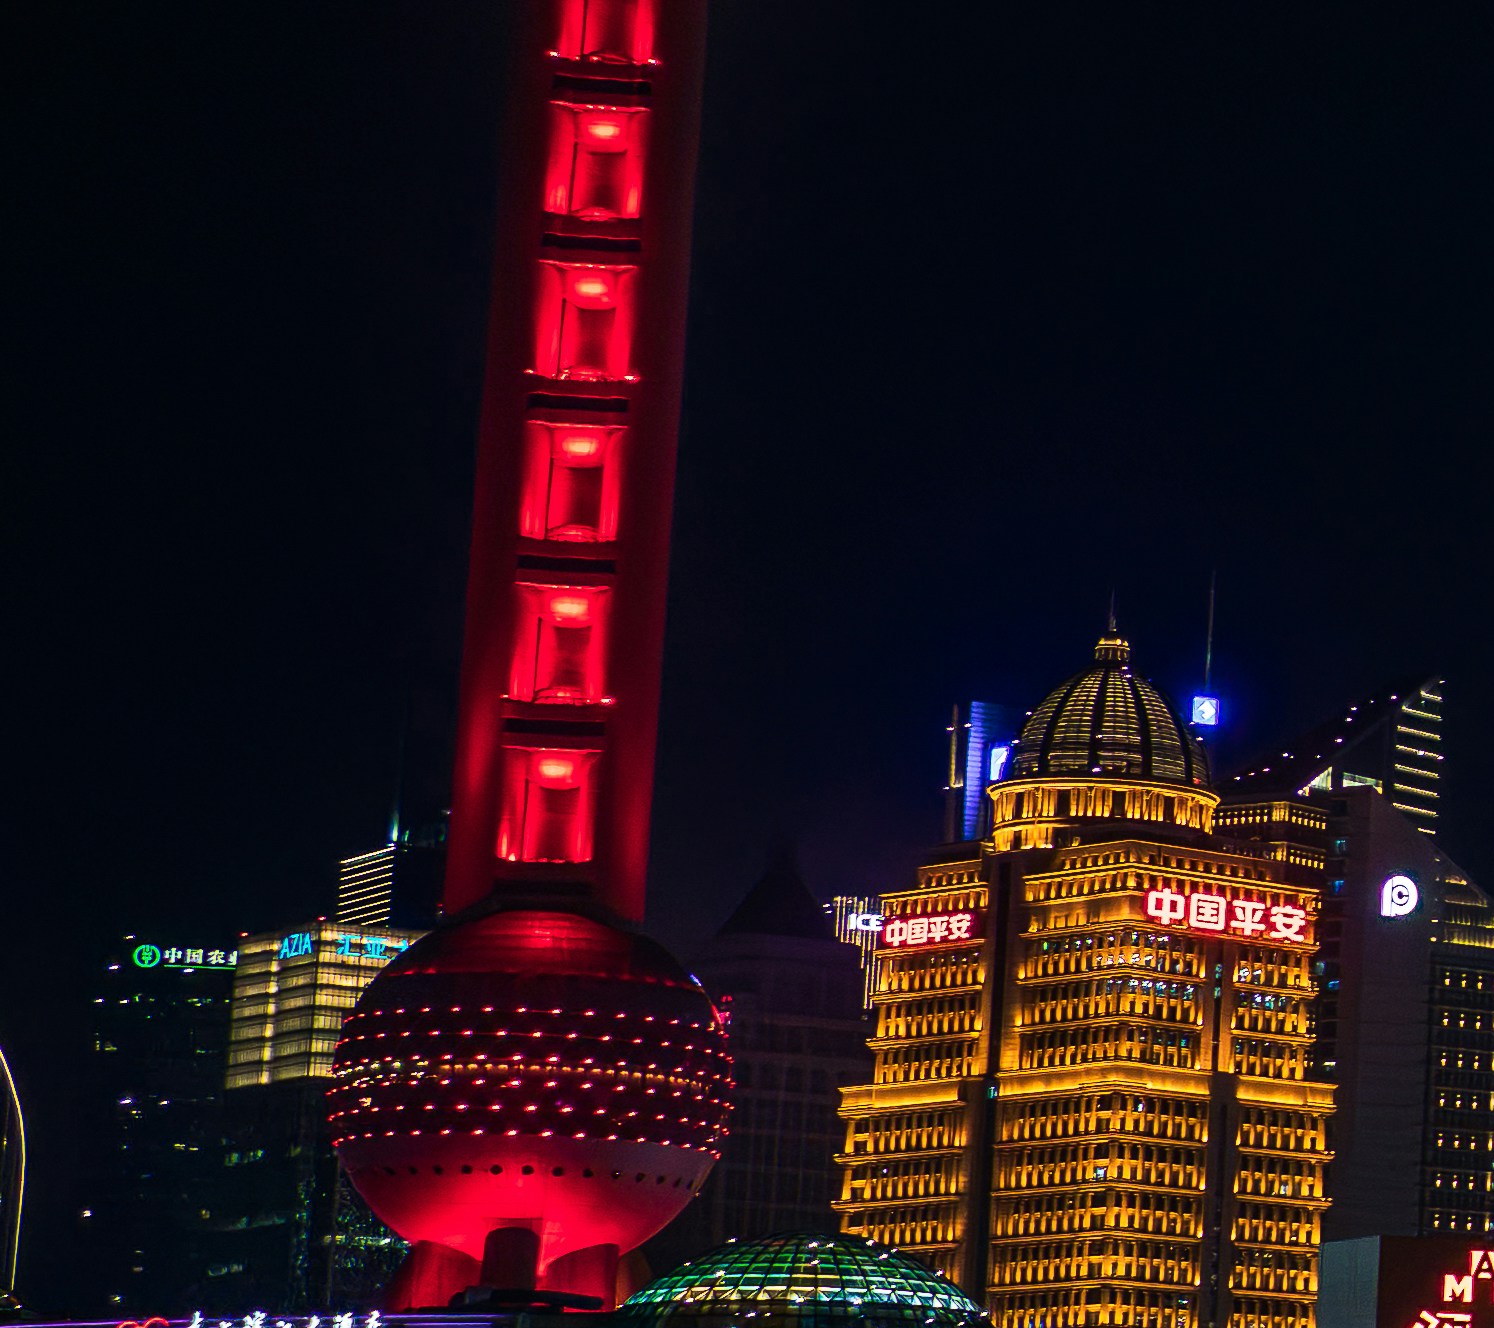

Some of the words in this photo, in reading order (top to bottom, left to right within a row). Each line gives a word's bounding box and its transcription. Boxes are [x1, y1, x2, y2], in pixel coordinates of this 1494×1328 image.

[886, 913, 972, 947] 中国平安
[1146, 888, 1306, 943] 中国平安
[279, 932, 313, 960] AZIA
